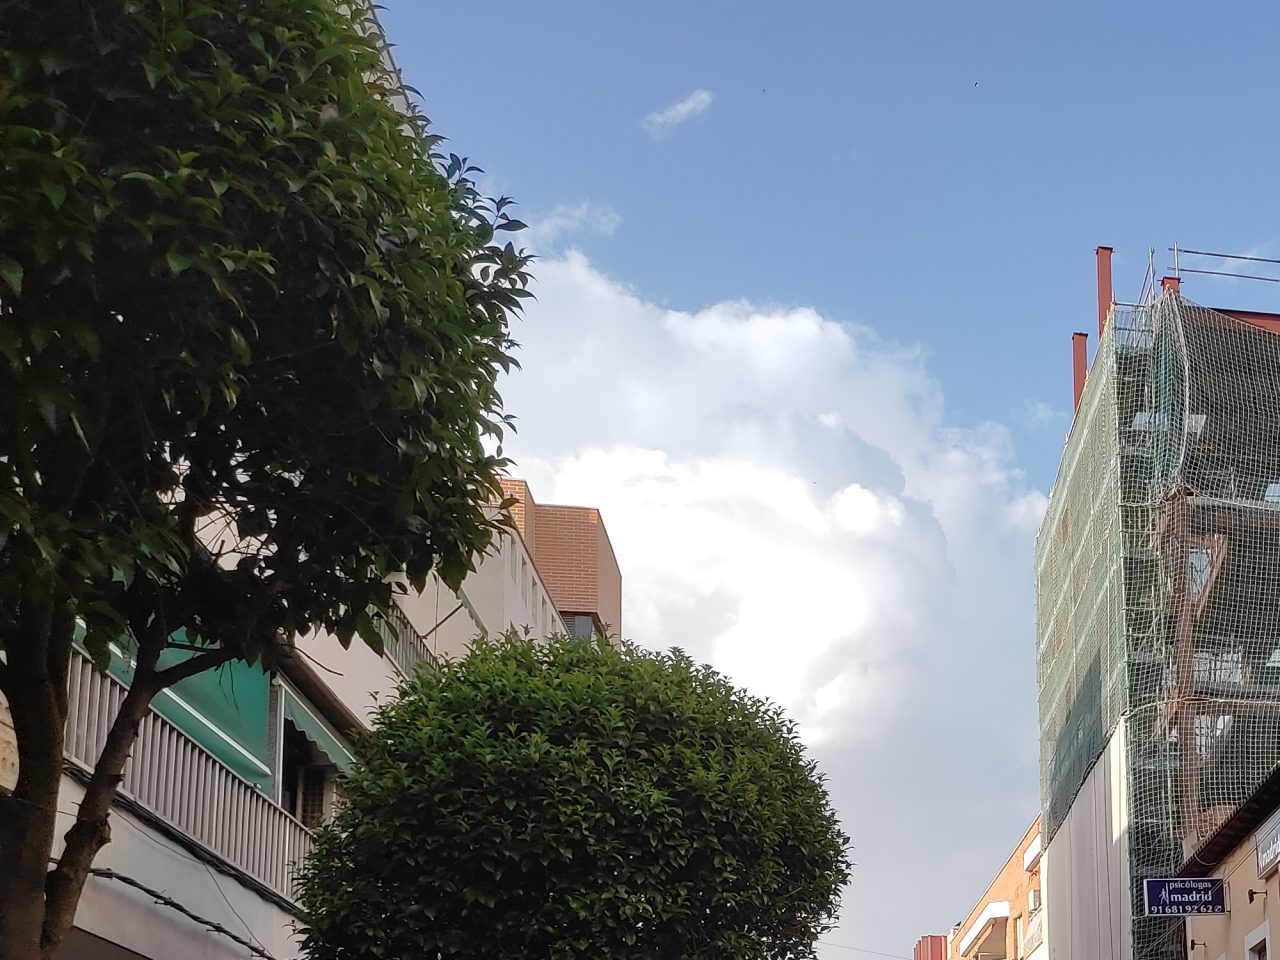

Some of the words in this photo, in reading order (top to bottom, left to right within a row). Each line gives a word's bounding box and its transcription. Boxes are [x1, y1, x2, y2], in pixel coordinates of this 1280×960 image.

[1262, 833, 1280, 868] madrid
[1169, 881, 1212, 890] psicólogos
[1171, 890, 1213, 902] madrid
[1151, 905, 1163, 914] 91
[1165, 905, 1183, 914] 681
[1186, 905, 1198, 914] 92
[1200, 904, 1213, 913] 62
